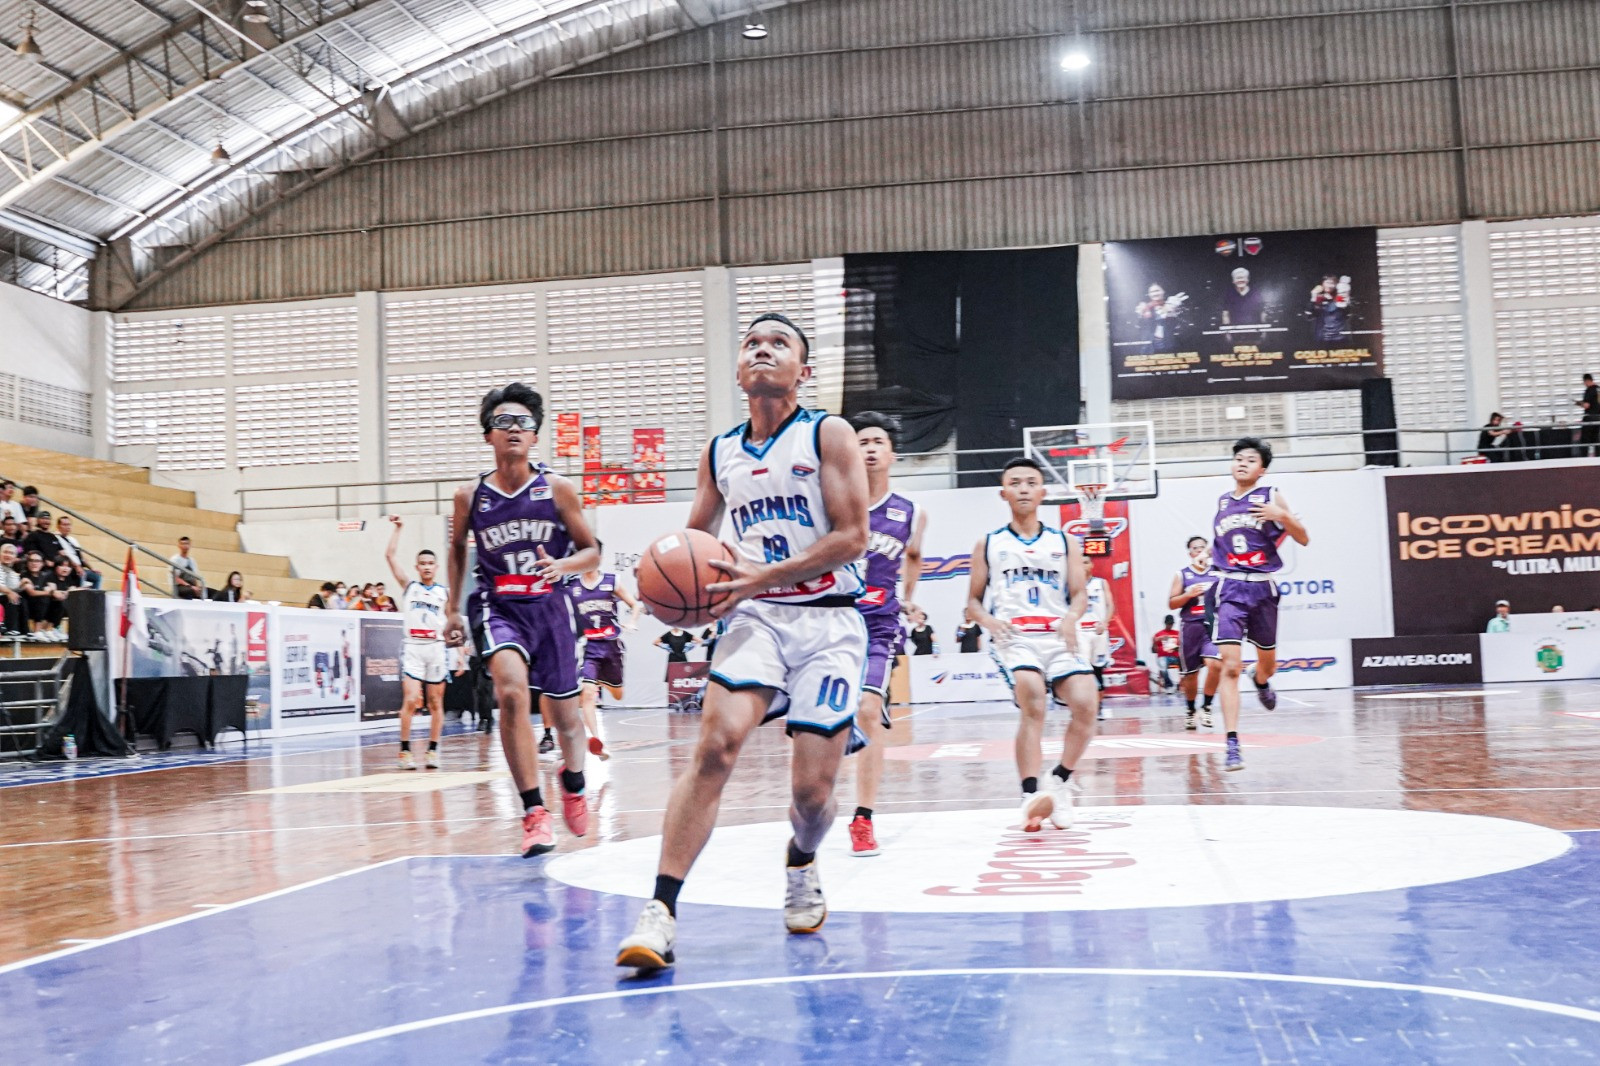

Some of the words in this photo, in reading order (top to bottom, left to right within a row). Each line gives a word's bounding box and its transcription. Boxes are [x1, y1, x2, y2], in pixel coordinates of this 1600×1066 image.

[1294, 350, 1328, 359] GOLD
[1085, 541, 1106, 554] 21
[1399, 539, 1462, 560] ICE
[1465, 532, 1600, 557] CREAM
[503, 549, 538, 576] 12
[1506, 558, 1562, 575] ULTRA
[1563, 556, 1600, 572] MIL
[1277, 579, 1335, 595] OTOR
[1362, 653, 1473, 668] AZAWEAR.COM
[816, 675, 850, 712] 10
